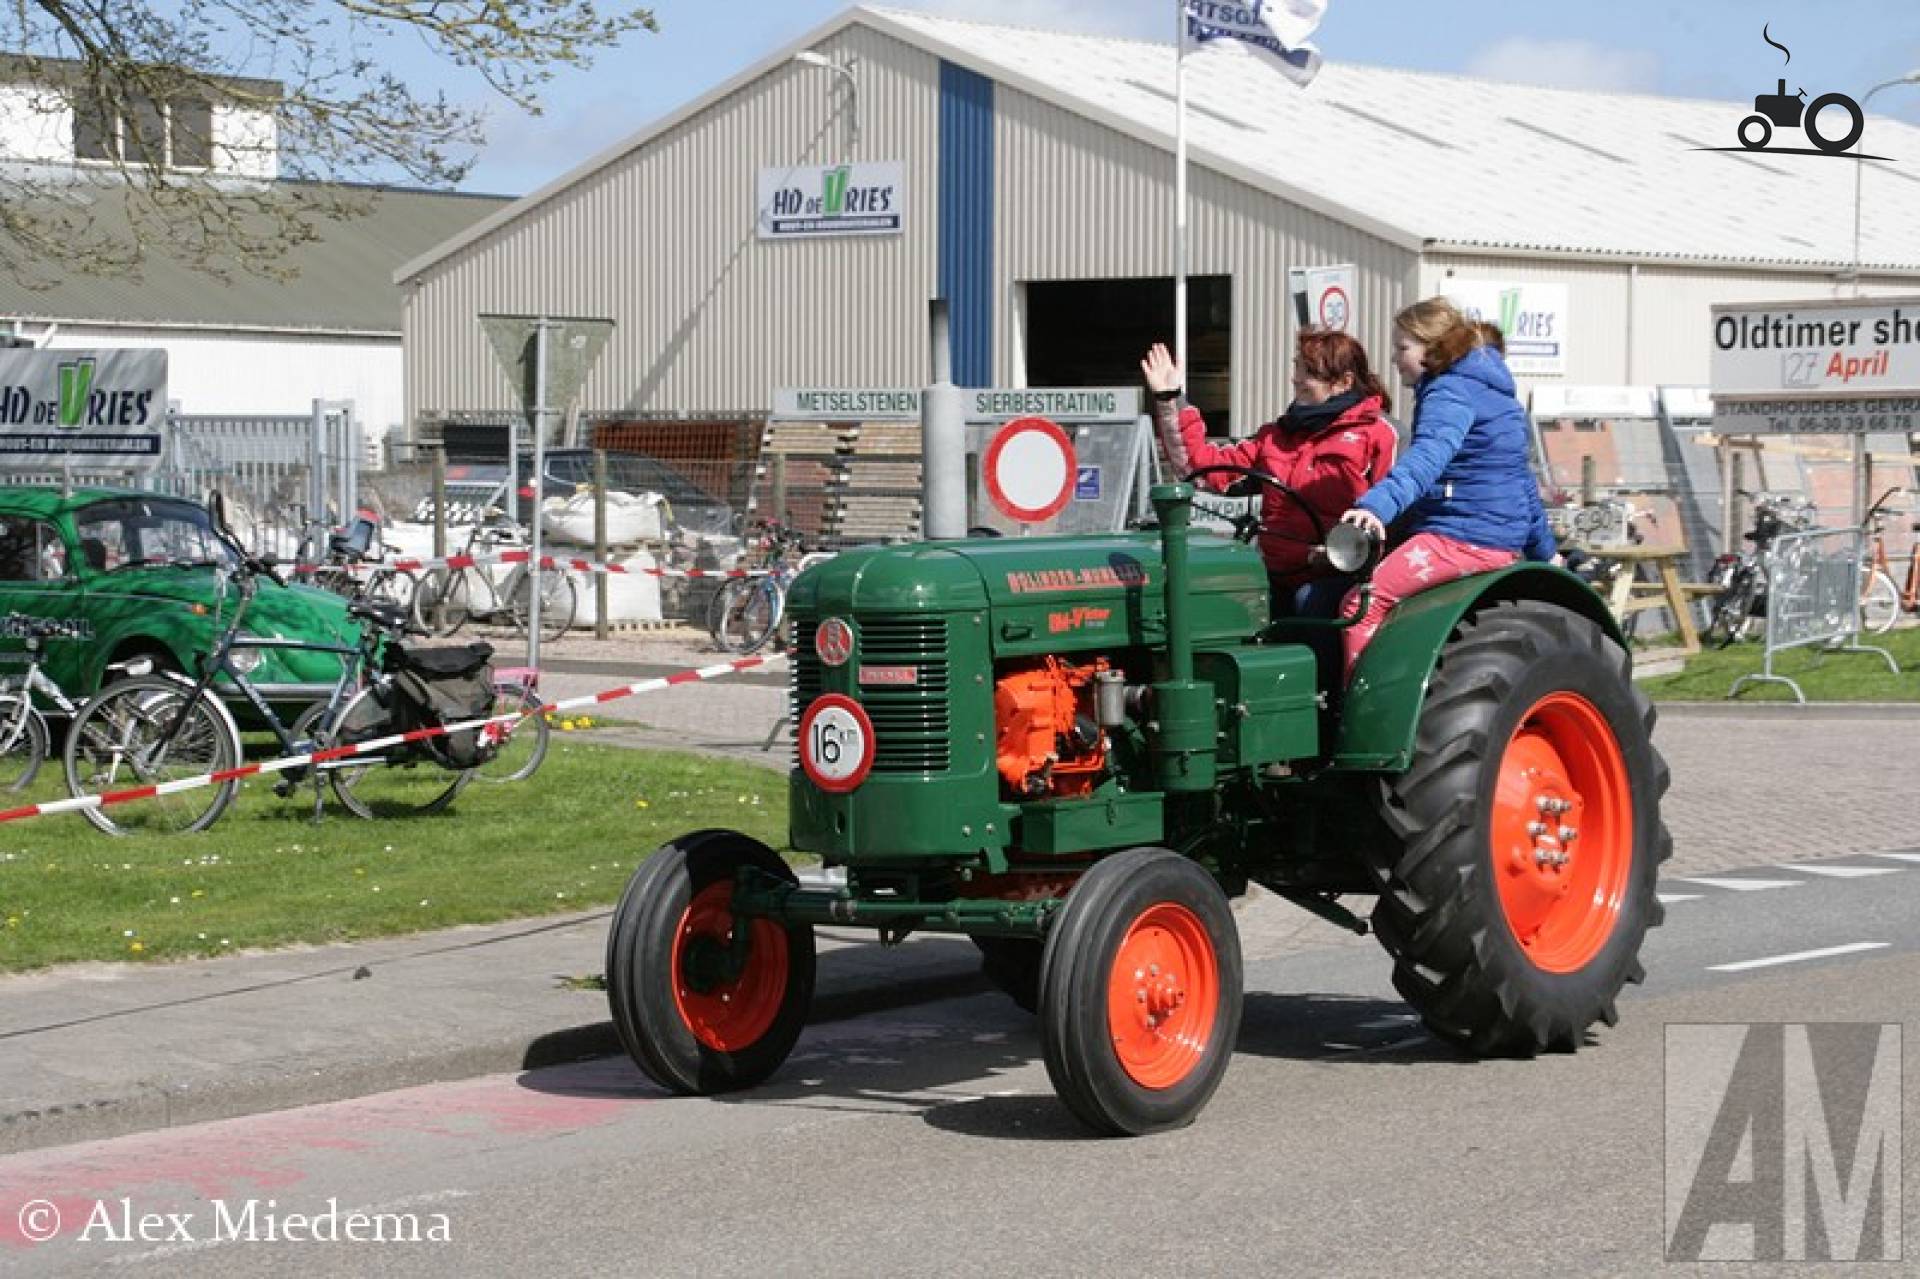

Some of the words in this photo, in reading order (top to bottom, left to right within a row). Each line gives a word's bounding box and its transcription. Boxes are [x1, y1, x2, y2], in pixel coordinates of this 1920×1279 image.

[773, 187, 803, 214] HD
[805, 197, 822, 213] DE
[1715, 314, 1861, 350] Oldtimer
[1825, 350, 1890, 384] April
[33, 400, 58, 423] DE
[57, 357, 153, 430] VRIES
[796, 391, 918, 412] METSELSTENEN
[976, 392, 1117, 413] SIERBESTRATING
[1716, 400, 1858, 417] STANDHOUDERS
[813, 724, 841, 764] 16
